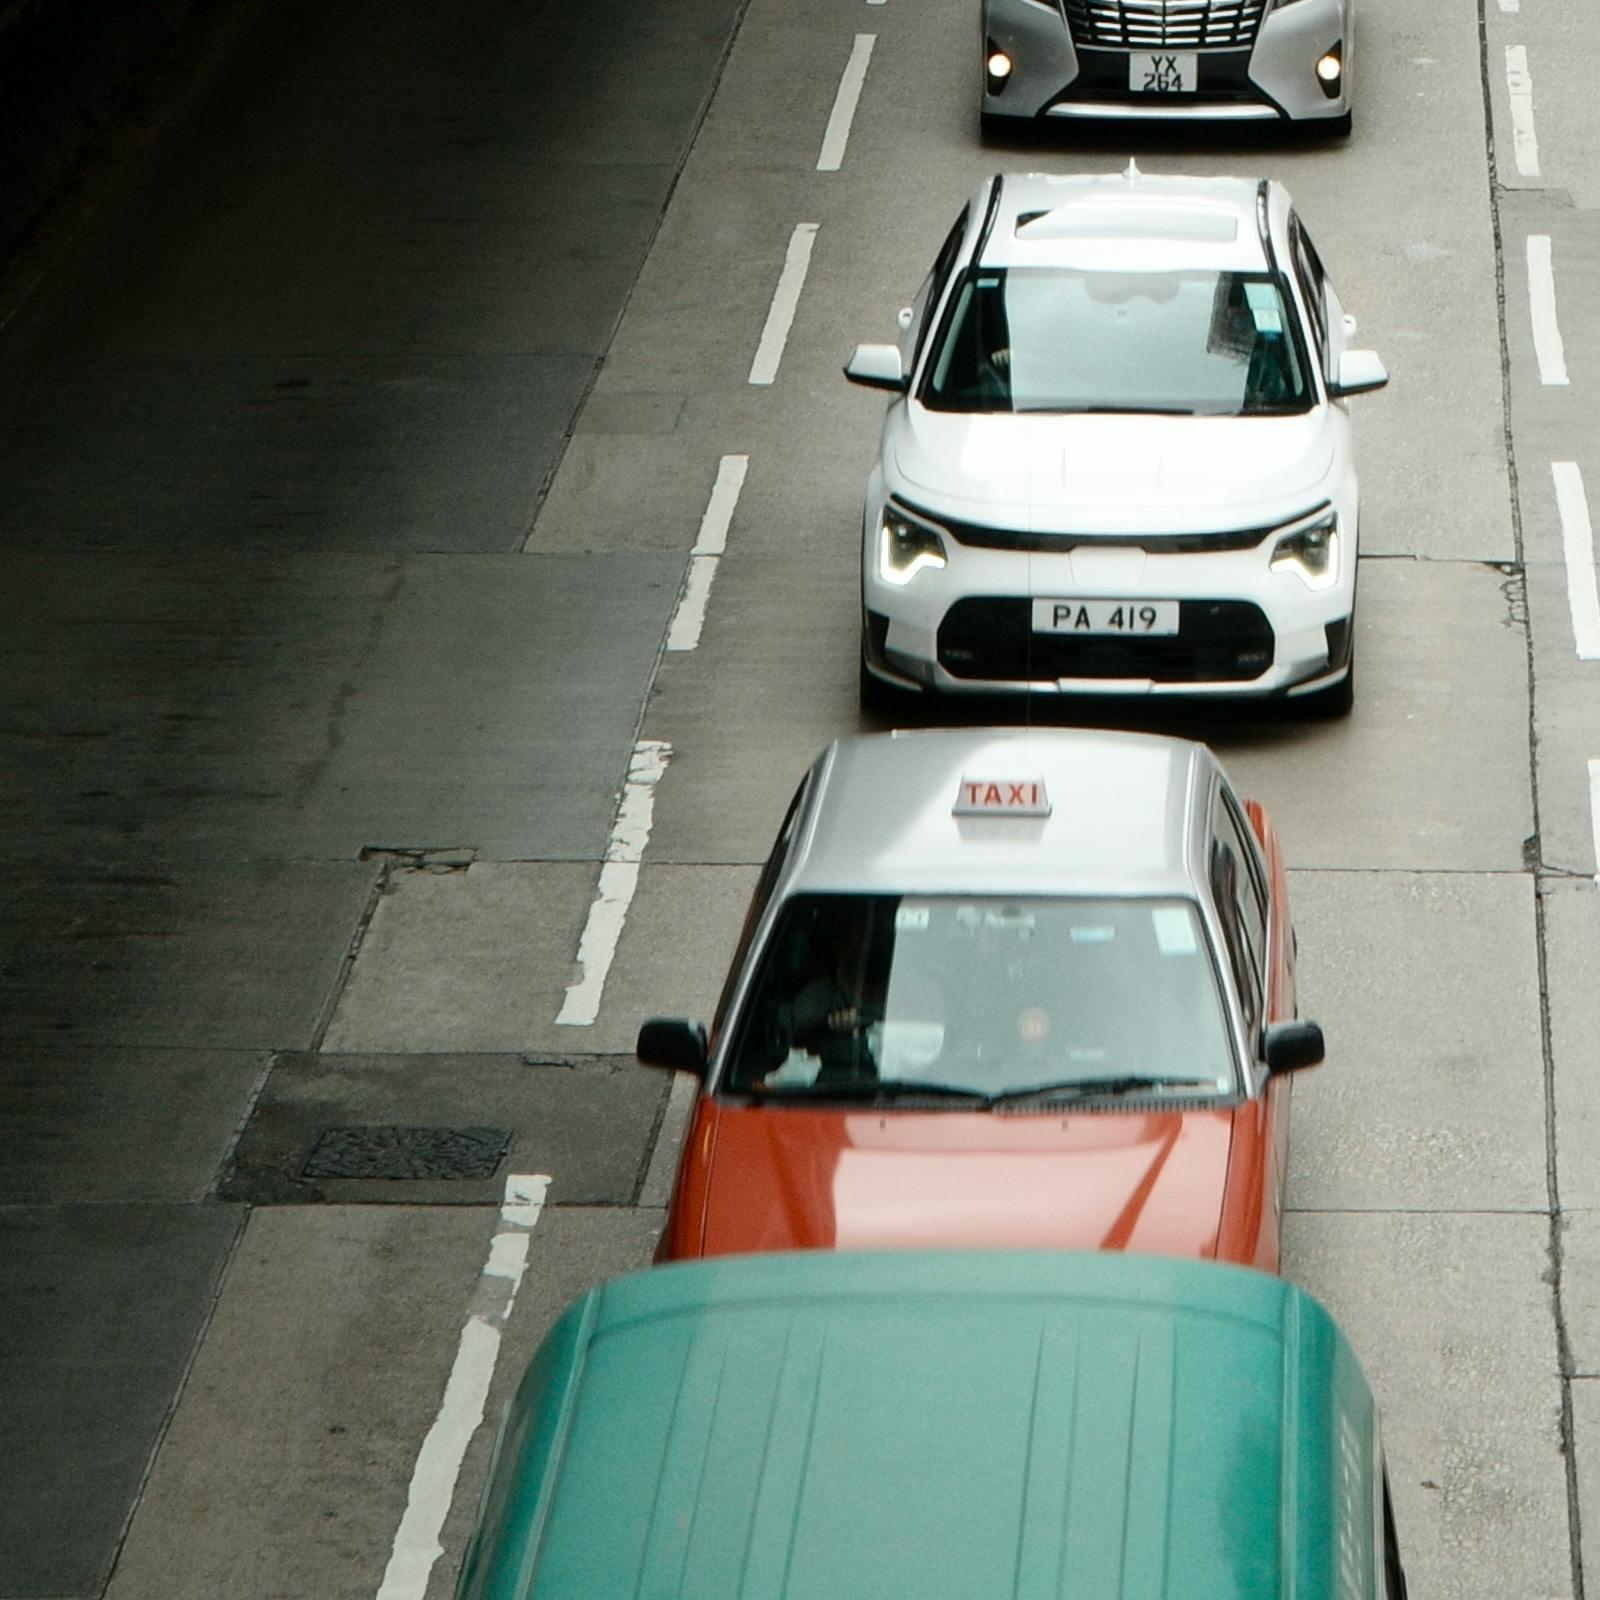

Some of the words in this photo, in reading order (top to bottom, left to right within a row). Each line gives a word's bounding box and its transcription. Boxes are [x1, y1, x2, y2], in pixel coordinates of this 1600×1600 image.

[1151, 55, 1177, 74] YX
[1144, 73, 1183, 92] 264
[1052, 605, 1091, 630] PA
[1107, 605, 1157, 630] 419
[965, 782, 1040, 808] TAXI
